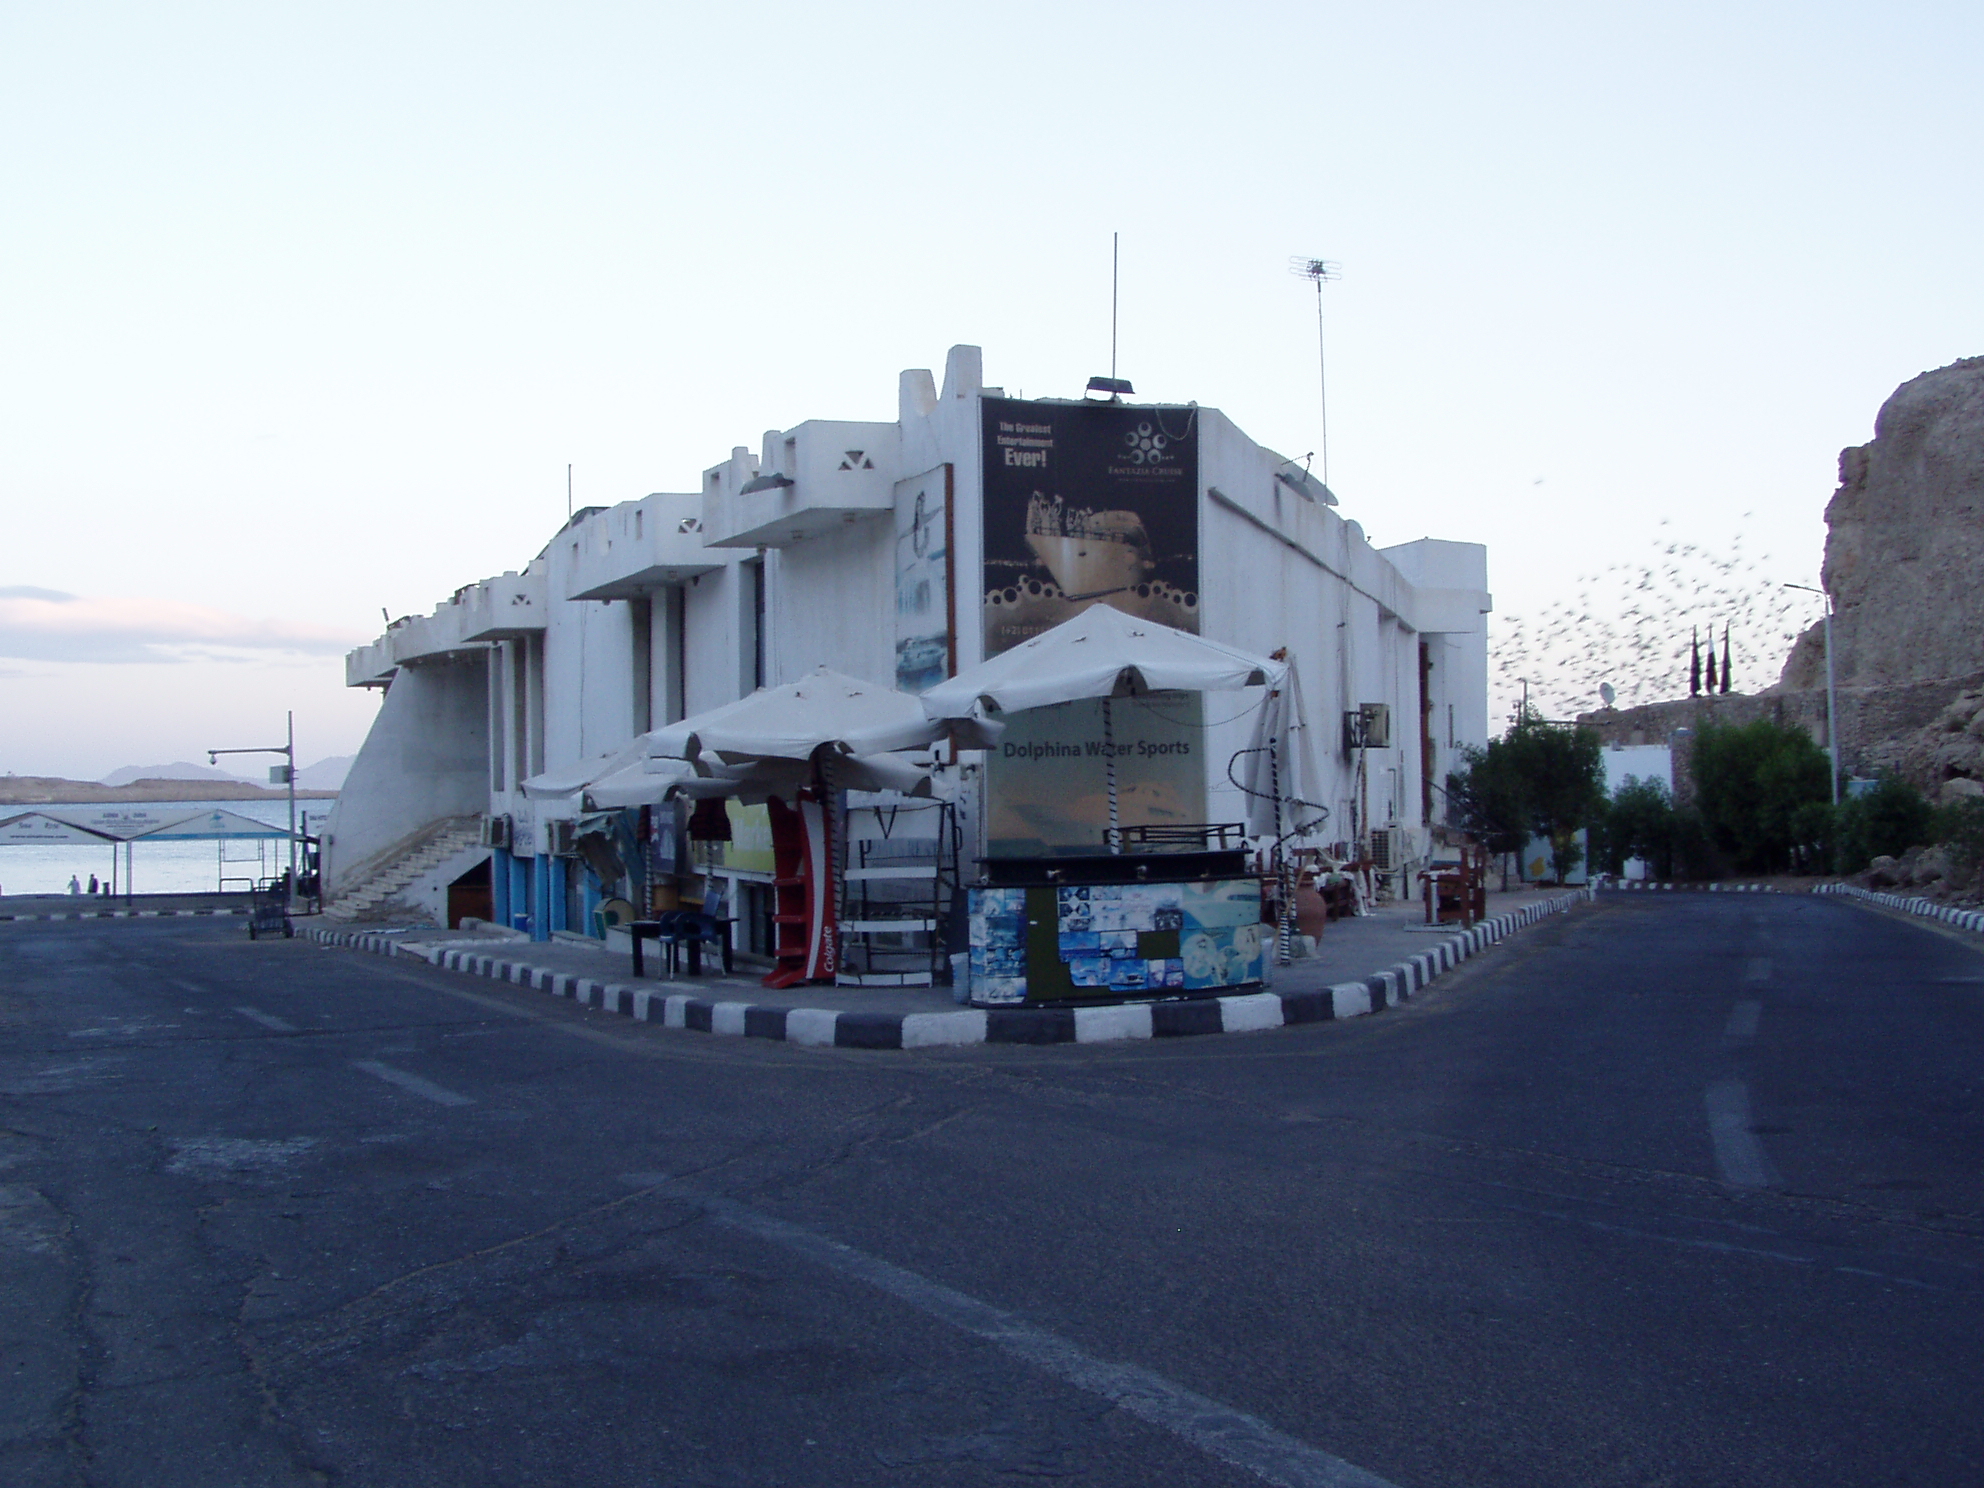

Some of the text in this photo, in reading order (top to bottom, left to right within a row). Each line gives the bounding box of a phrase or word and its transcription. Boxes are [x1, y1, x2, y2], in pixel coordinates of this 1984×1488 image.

[1005, 447, 1047, 467] Ever!
[1004, 742, 1081, 761] Dolphina
[1137, 740, 1190, 758] Sports
[823, 925, 836, 972] Colgate
